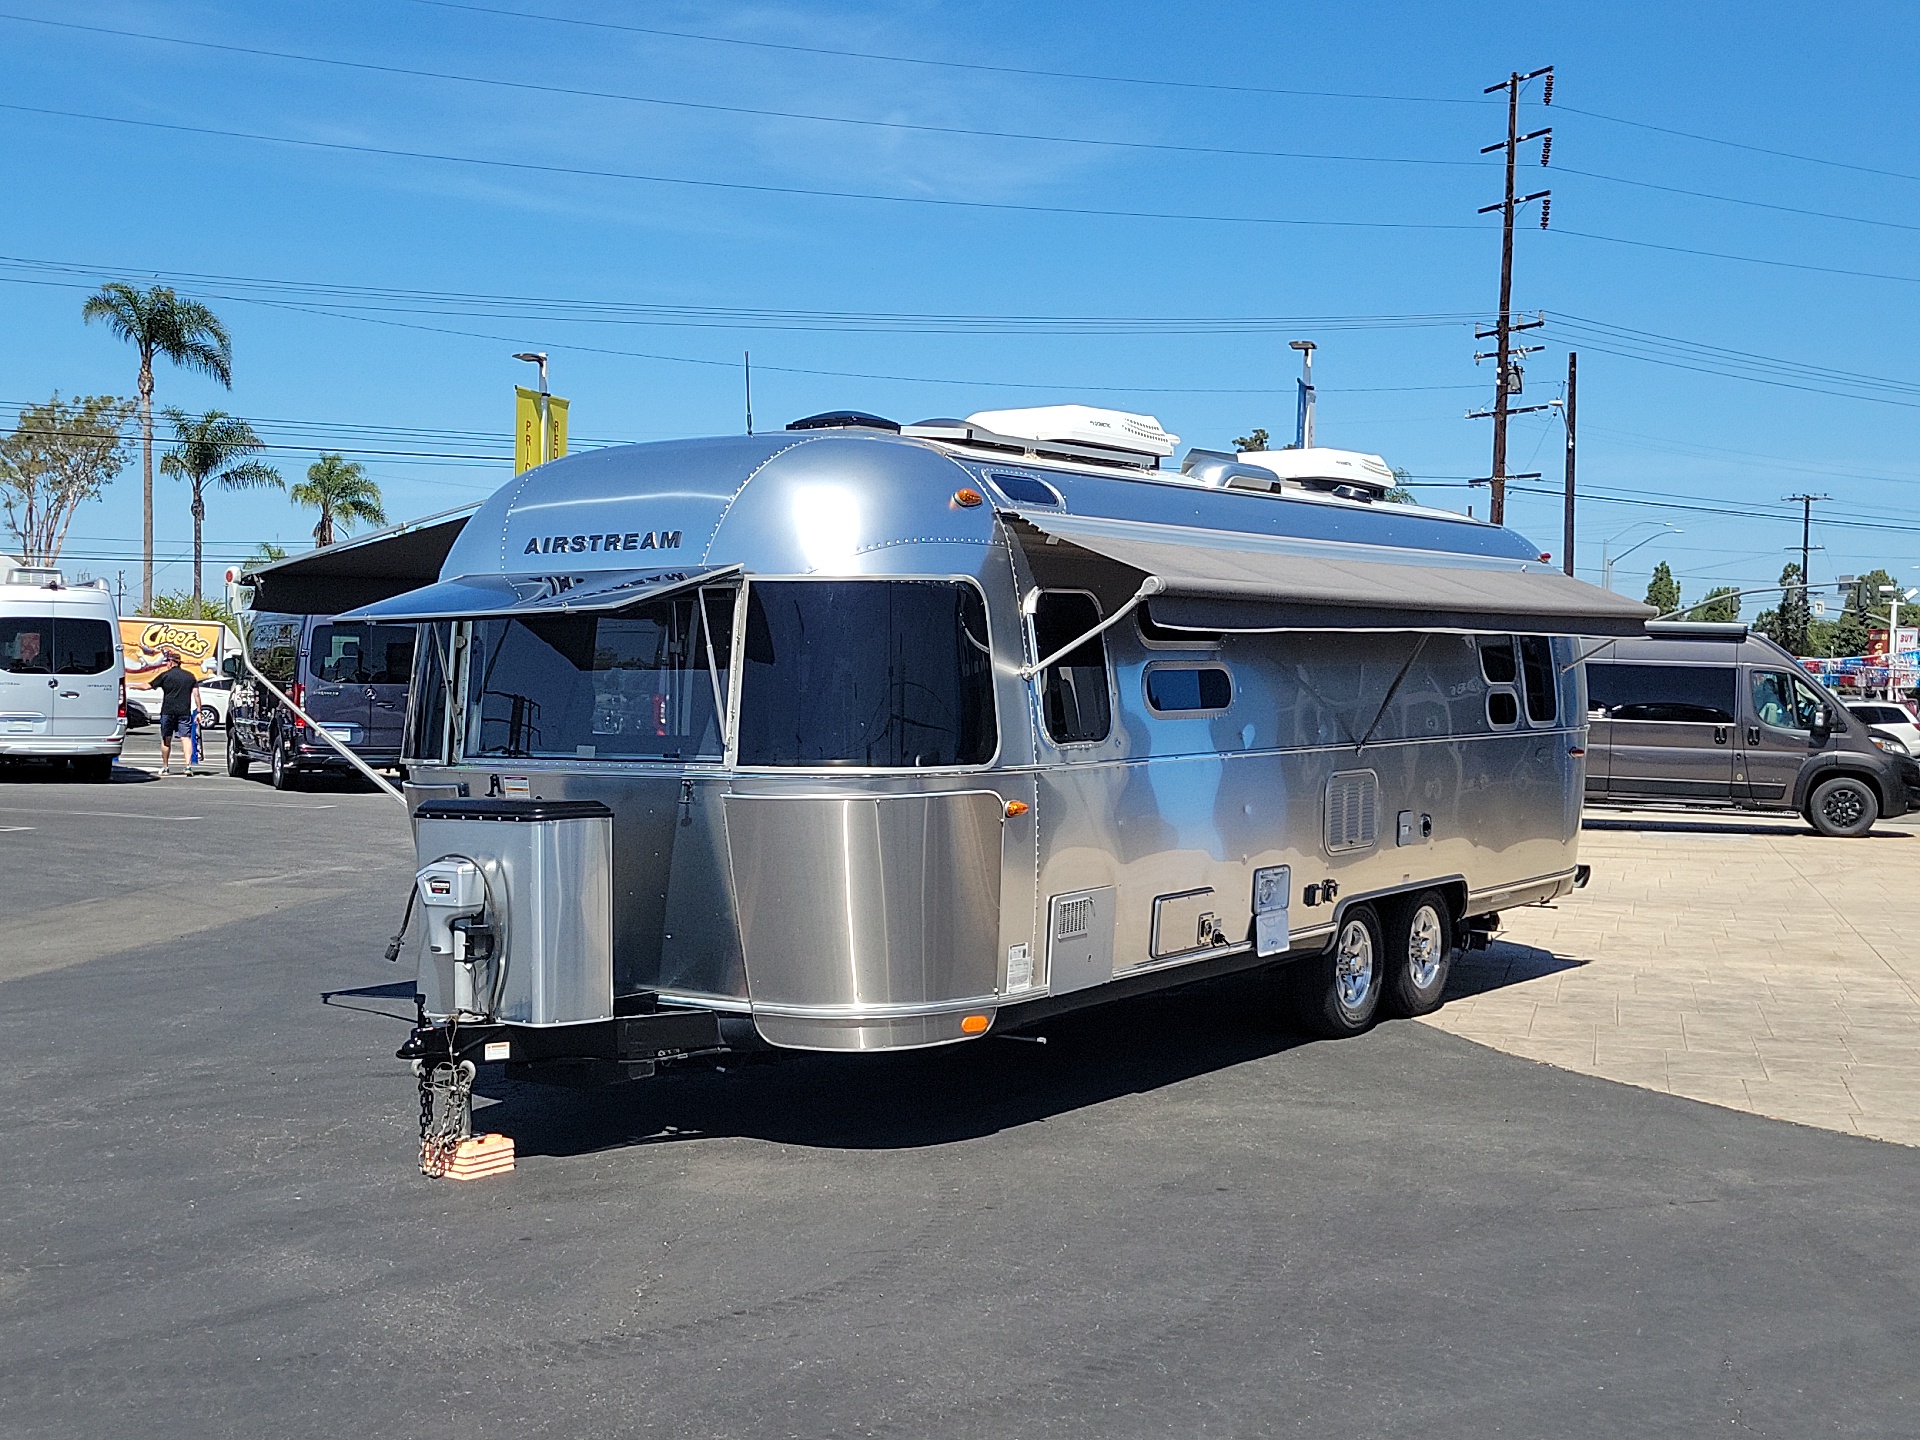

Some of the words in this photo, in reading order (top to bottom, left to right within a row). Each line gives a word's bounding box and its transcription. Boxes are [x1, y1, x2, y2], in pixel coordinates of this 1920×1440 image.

[524, 531, 682, 555] AIRSTREAM
[142, 623, 209, 656] Cheetos
[1900, 634, 1913, 643] BUY
